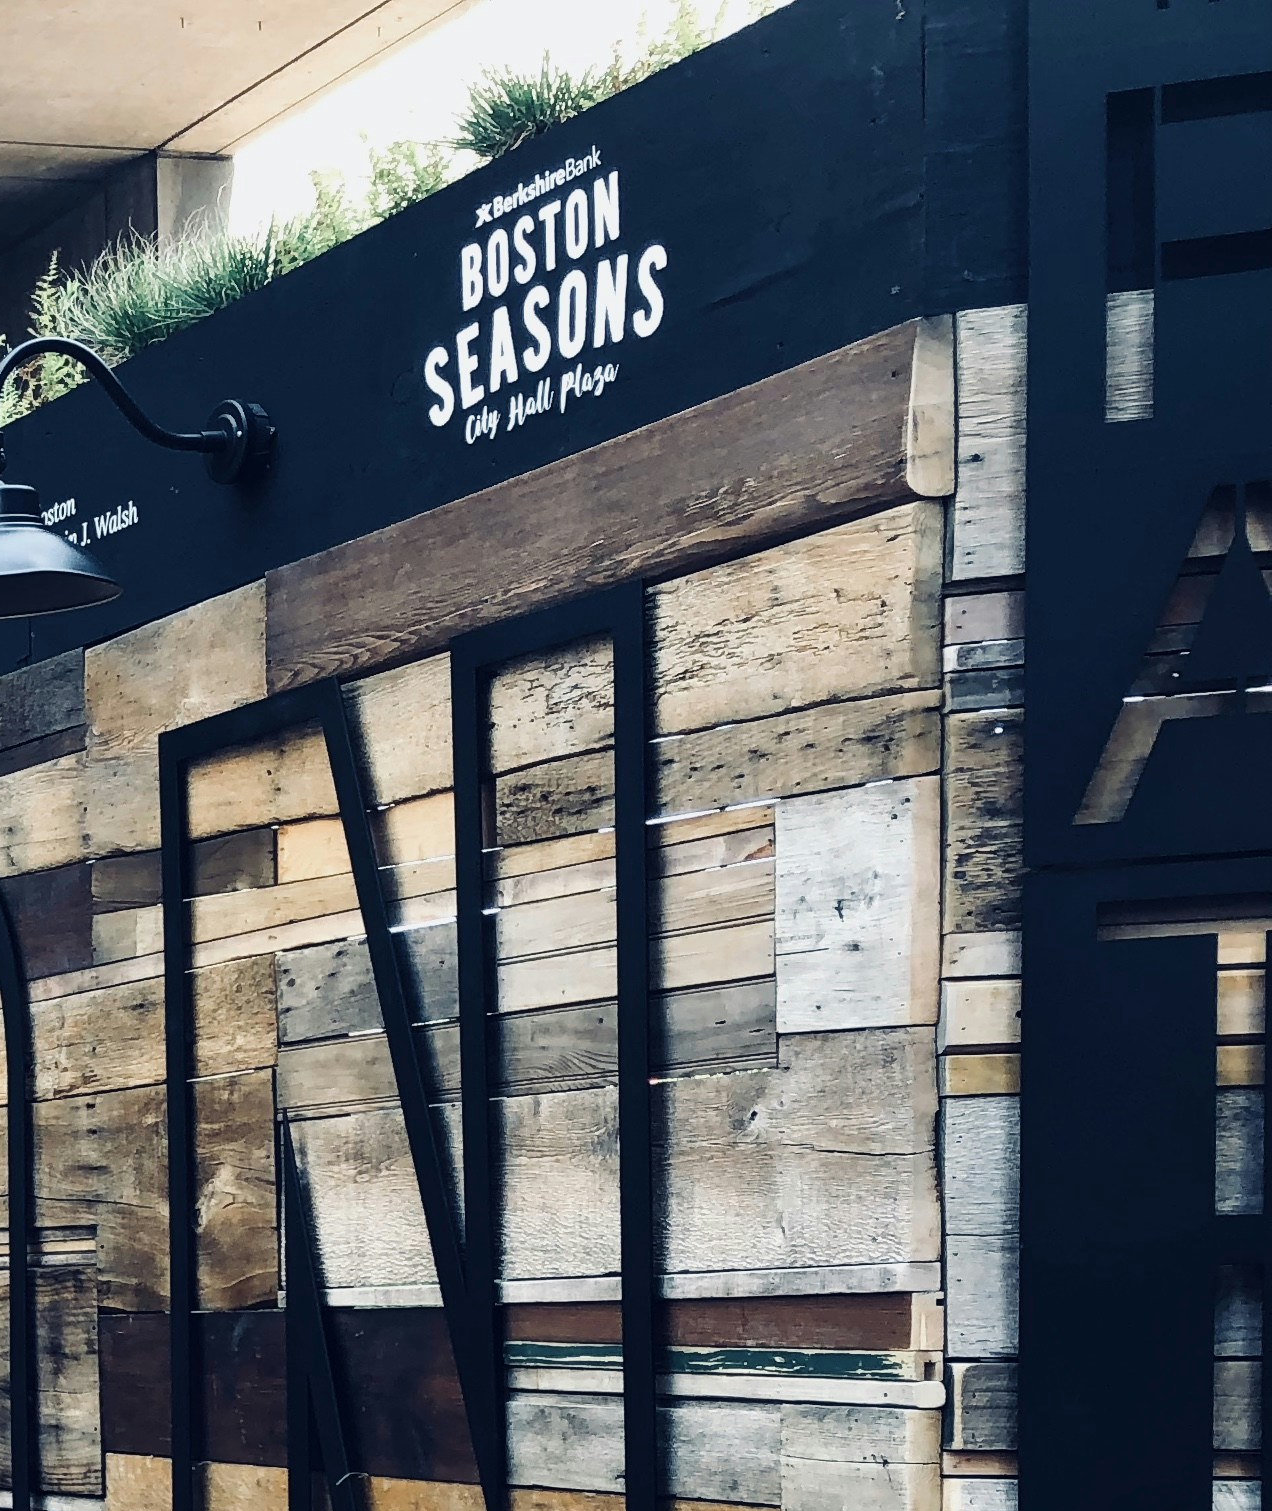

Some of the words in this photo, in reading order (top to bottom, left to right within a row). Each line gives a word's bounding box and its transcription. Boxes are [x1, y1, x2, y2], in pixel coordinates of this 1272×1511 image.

[493, 145, 602, 219] BerkshireBank
[461, 170, 620, 311] BOSTON
[424, 244, 668, 427] SEASONS
[465, 405, 501, 445] City
[507, 376, 554, 432] Hall
[560, 362, 620, 414] Plaza
[41, 498, 76, 526] oston
[80, 522, 91, 547] J.
[94, 500, 138, 540] Walsh
